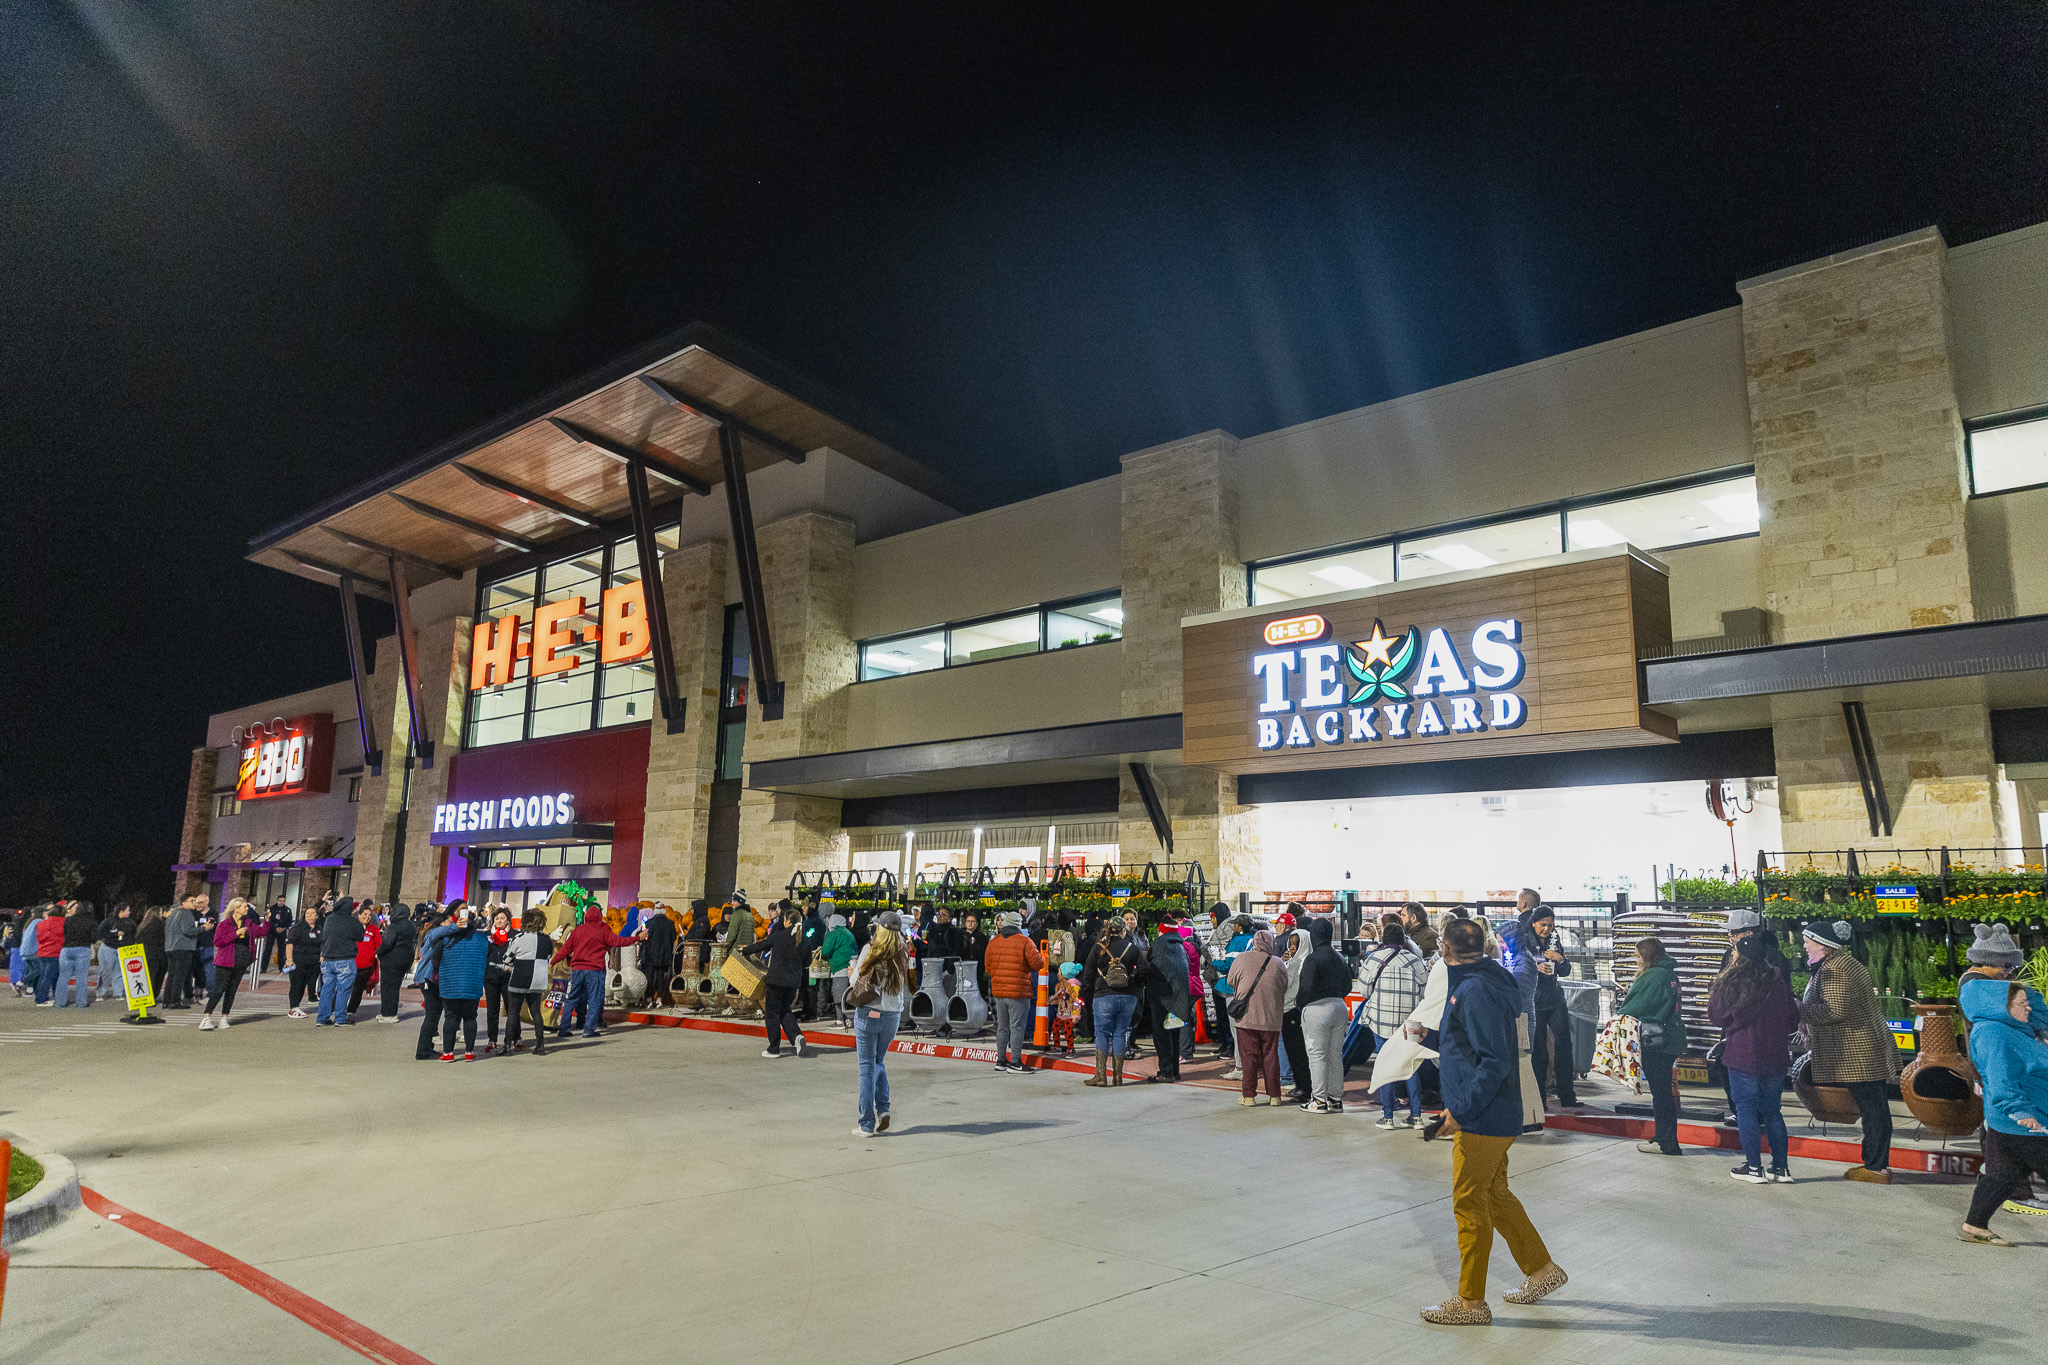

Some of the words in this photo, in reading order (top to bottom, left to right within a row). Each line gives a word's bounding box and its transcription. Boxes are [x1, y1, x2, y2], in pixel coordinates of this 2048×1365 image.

[1254, 617, 1522, 713] TEXAS
[1257, 692, 1523, 748] BACKYARD
[255, 736, 305, 788] BBQ
[434, 800, 496, 833] FRESH
[499, 793, 572, 829] FOODS
[1878, 900, 1885, 910] 2
[127, 961, 142, 971] STOP
[897, 1041, 914, 1053] FIRE
[916, 1043, 937, 1055] LANE
[952, 1046, 964, 1058] NO
[966, 1048, 999, 1062] PARKING
[1927, 1154, 1976, 1176] FIRE
